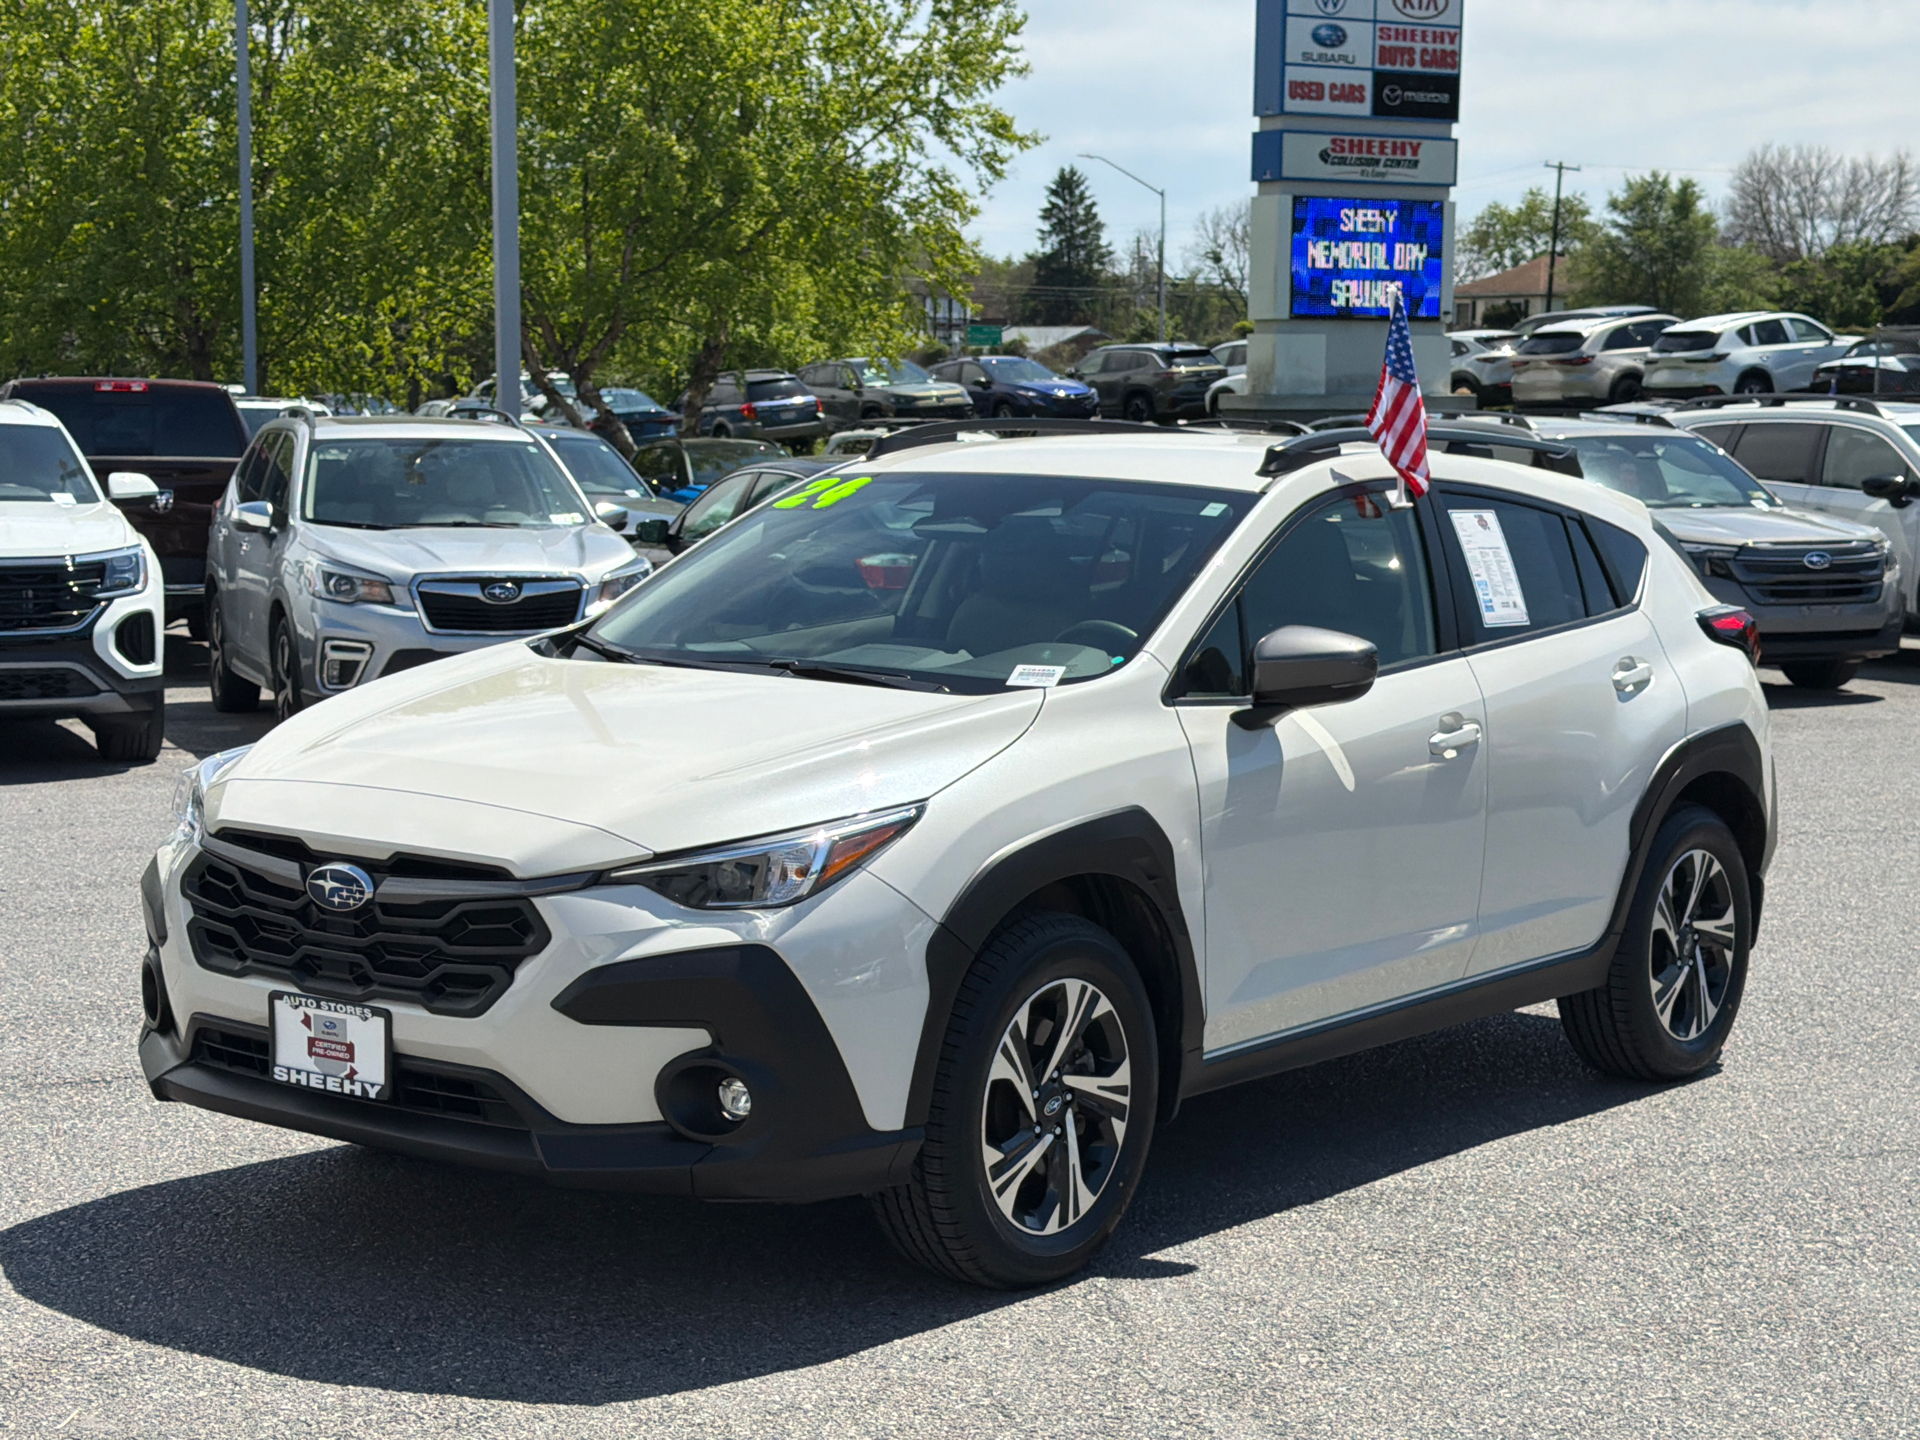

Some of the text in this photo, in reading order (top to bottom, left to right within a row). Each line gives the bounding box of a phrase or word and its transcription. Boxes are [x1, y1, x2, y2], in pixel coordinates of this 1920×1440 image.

[1378, 27, 1458, 45] SHEEHY
[1301, 51, 1356, 64] SUBARU
[1378, 45, 1458, 70] BUYS CARS
[1289, 80, 1366, 104] USED CARS
[1330, 138, 1422, 157] SHEEHY
[1330, 155, 1420, 170] COLLISION CENTER
[1308, 240, 1428, 271] MEMORIAL DAY
[772, 477, 872, 509] 24
[282, 995, 373, 1019] AUTO STORES
[312, 1047, 350, 1059] PRE-OWNED
[315, 1040, 347, 1051] CERTIFIED
[273, 1066, 383, 1099] SHEEHY
